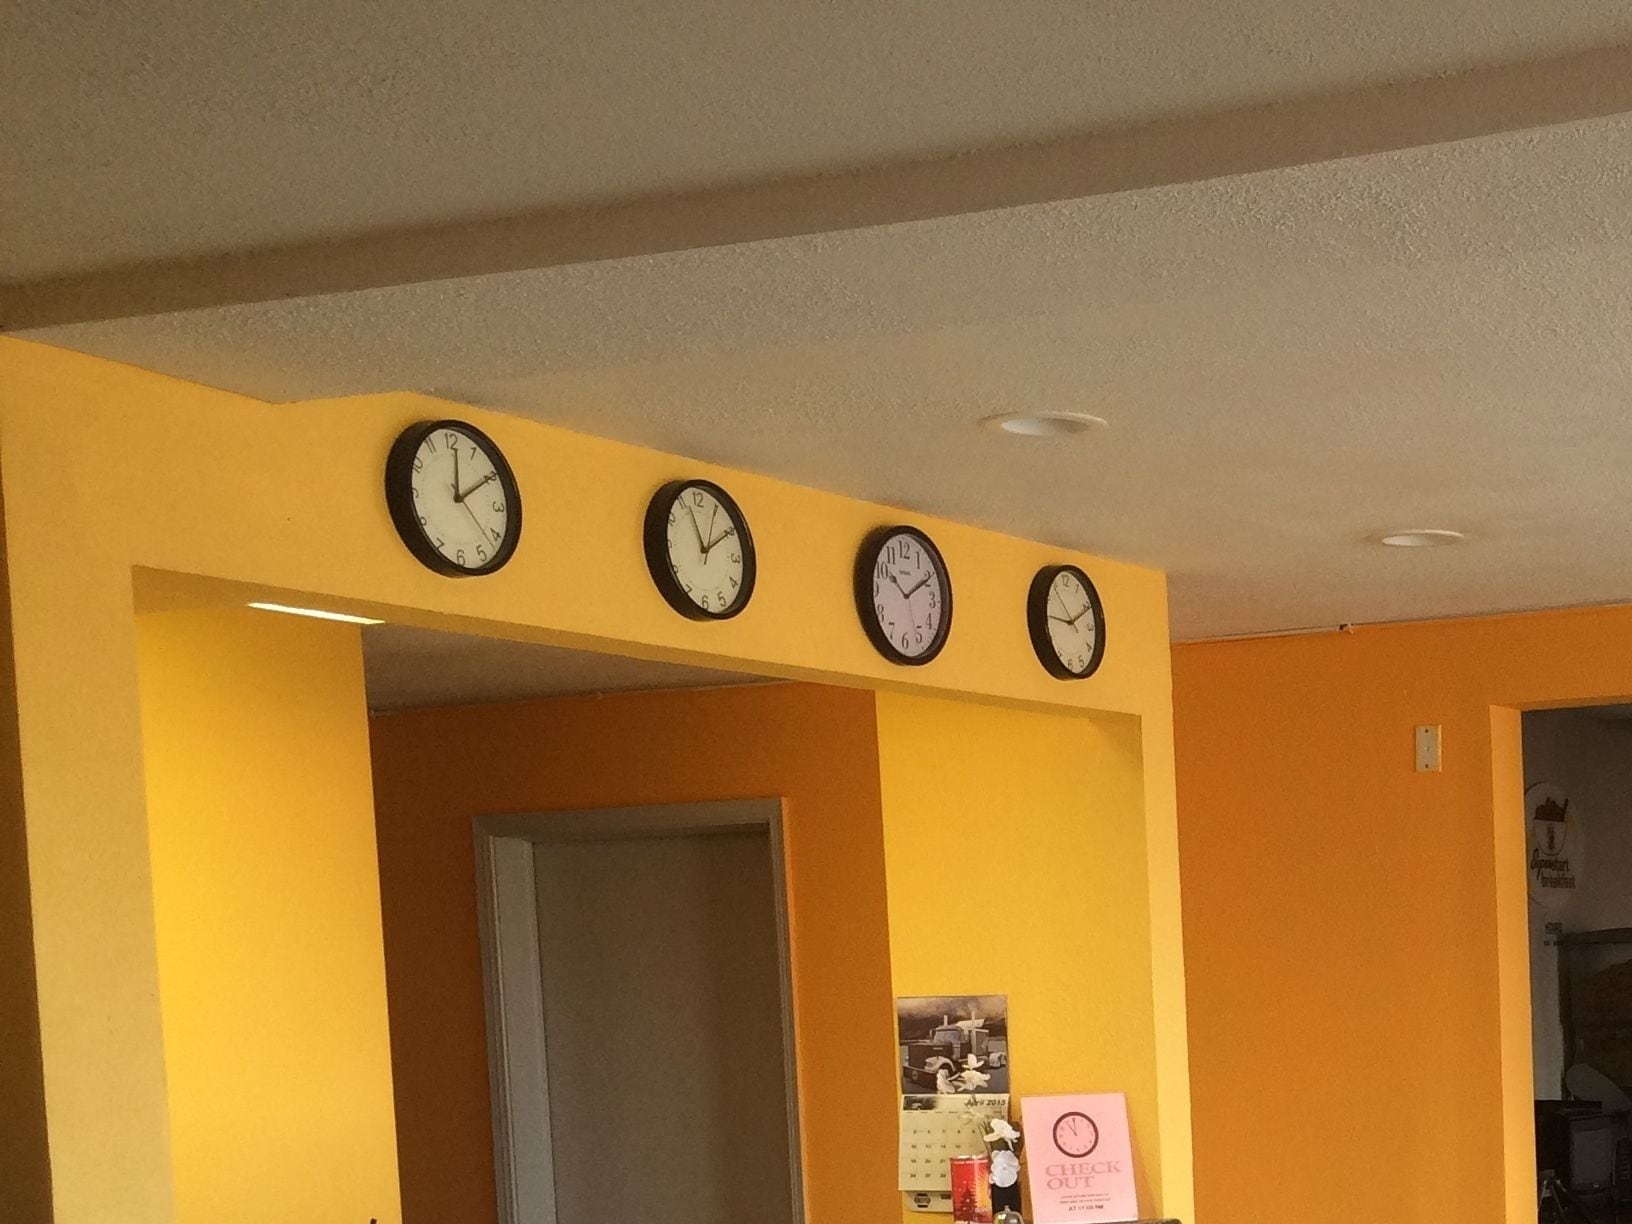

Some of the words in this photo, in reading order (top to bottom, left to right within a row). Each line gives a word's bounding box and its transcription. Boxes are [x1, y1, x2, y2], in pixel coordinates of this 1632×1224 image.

[424, 437, 437, 454] 11
[445, 433, 458, 450] 12
[470, 447, 477, 460] 1
[493, 501, 505, 513] 3
[692, 492, 704, 508] 12
[490, 528, 502, 542] 4
[456, 550, 466, 567] 6
[476, 545, 487, 562] 5
[731, 553, 741, 564] 3
[886, 546, 896, 565] 11
[898, 541, 910, 560] 12
[915, 551, 920, 569] 1
[876, 561, 889, 579] 10
[729, 576, 739, 589] 4
[1061, 574, 1069, 588] 12
[701, 595, 709, 611] 6
[717, 591, 727, 607] 5
[929, 592, 936, 609] 3
[877, 604, 884, 622] 8
[926, 613, 932, 630] 4
[888, 622, 895, 640] 7
[915, 625, 922, 644] 5
[901, 632, 909, 649] 6
[1045, 1161, 1121, 1177] CHECK
[1046, 1176, 1095, 1190] OUT
